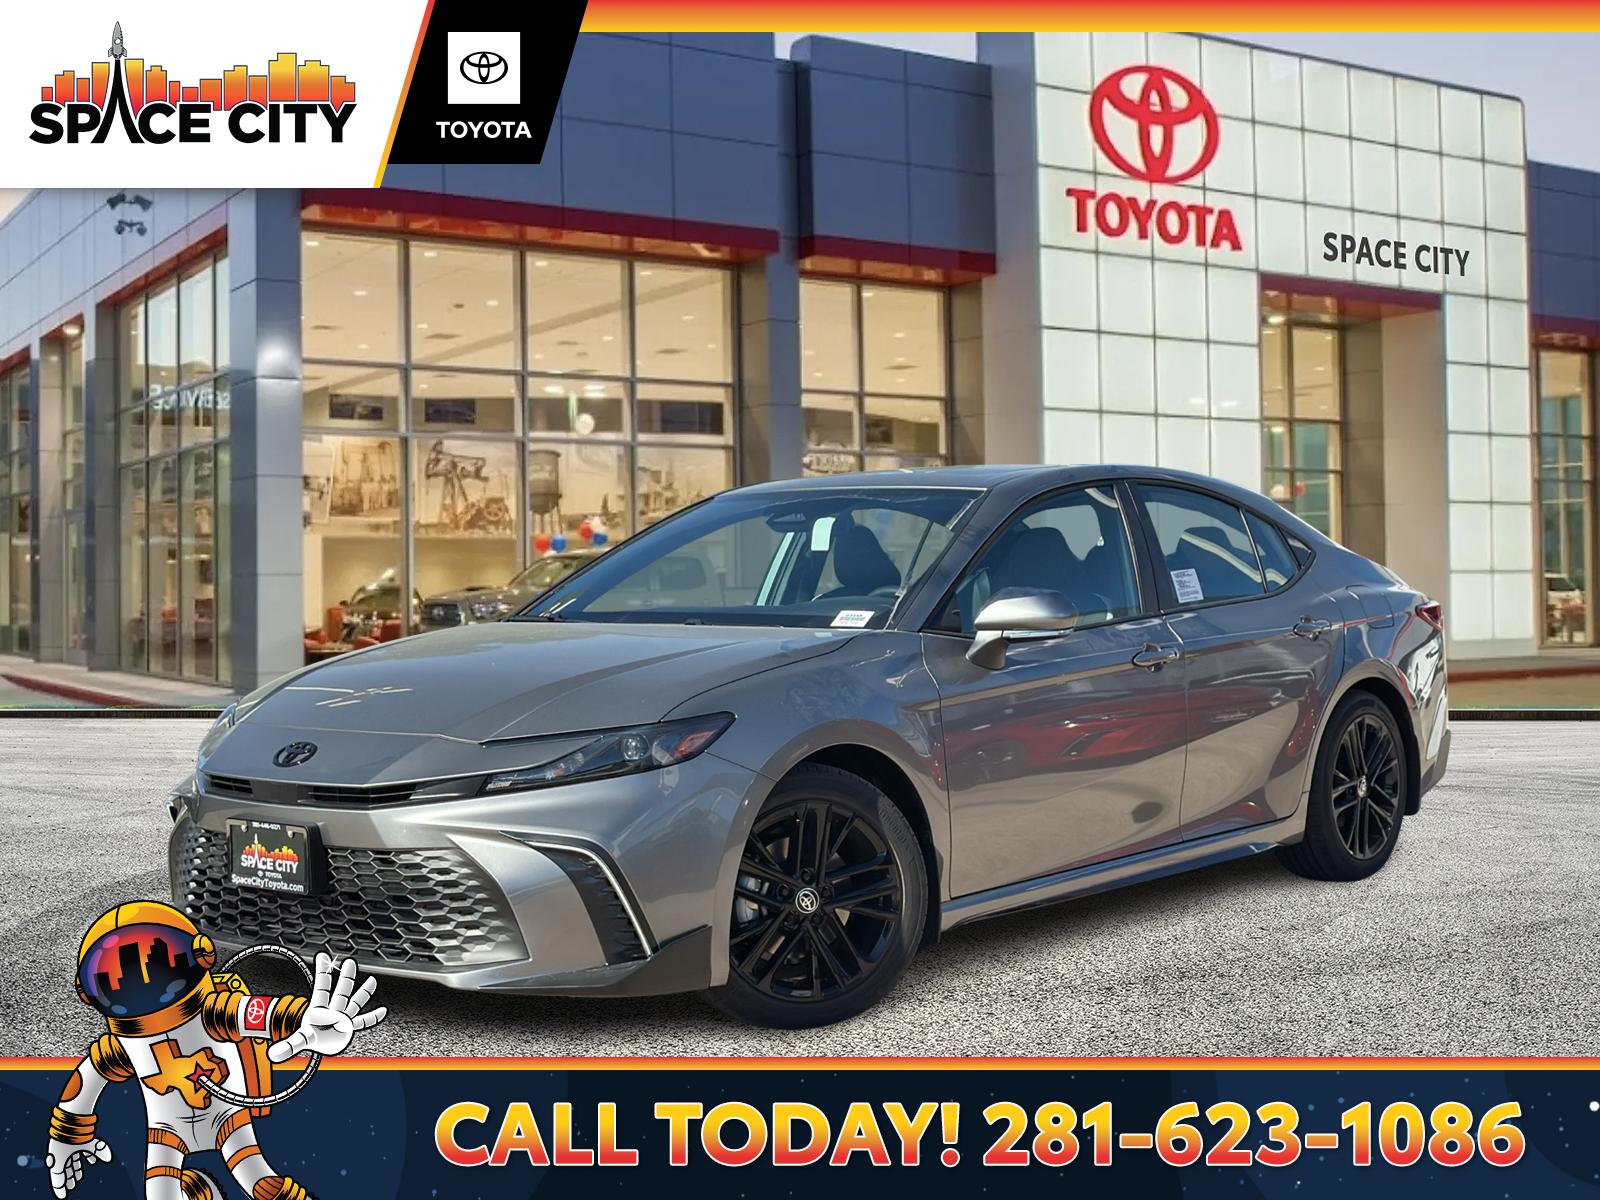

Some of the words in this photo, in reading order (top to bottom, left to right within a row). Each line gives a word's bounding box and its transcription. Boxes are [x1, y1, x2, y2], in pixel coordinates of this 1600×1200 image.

[1067, 188, 1242, 251] TOYOTA
[1323, 232, 1407, 270] SPACE
[1414, 244, 1470, 277] CITY
[275, 859, 299, 874] CITY
[231, 874, 304, 892] SpaceCityToyota.com
